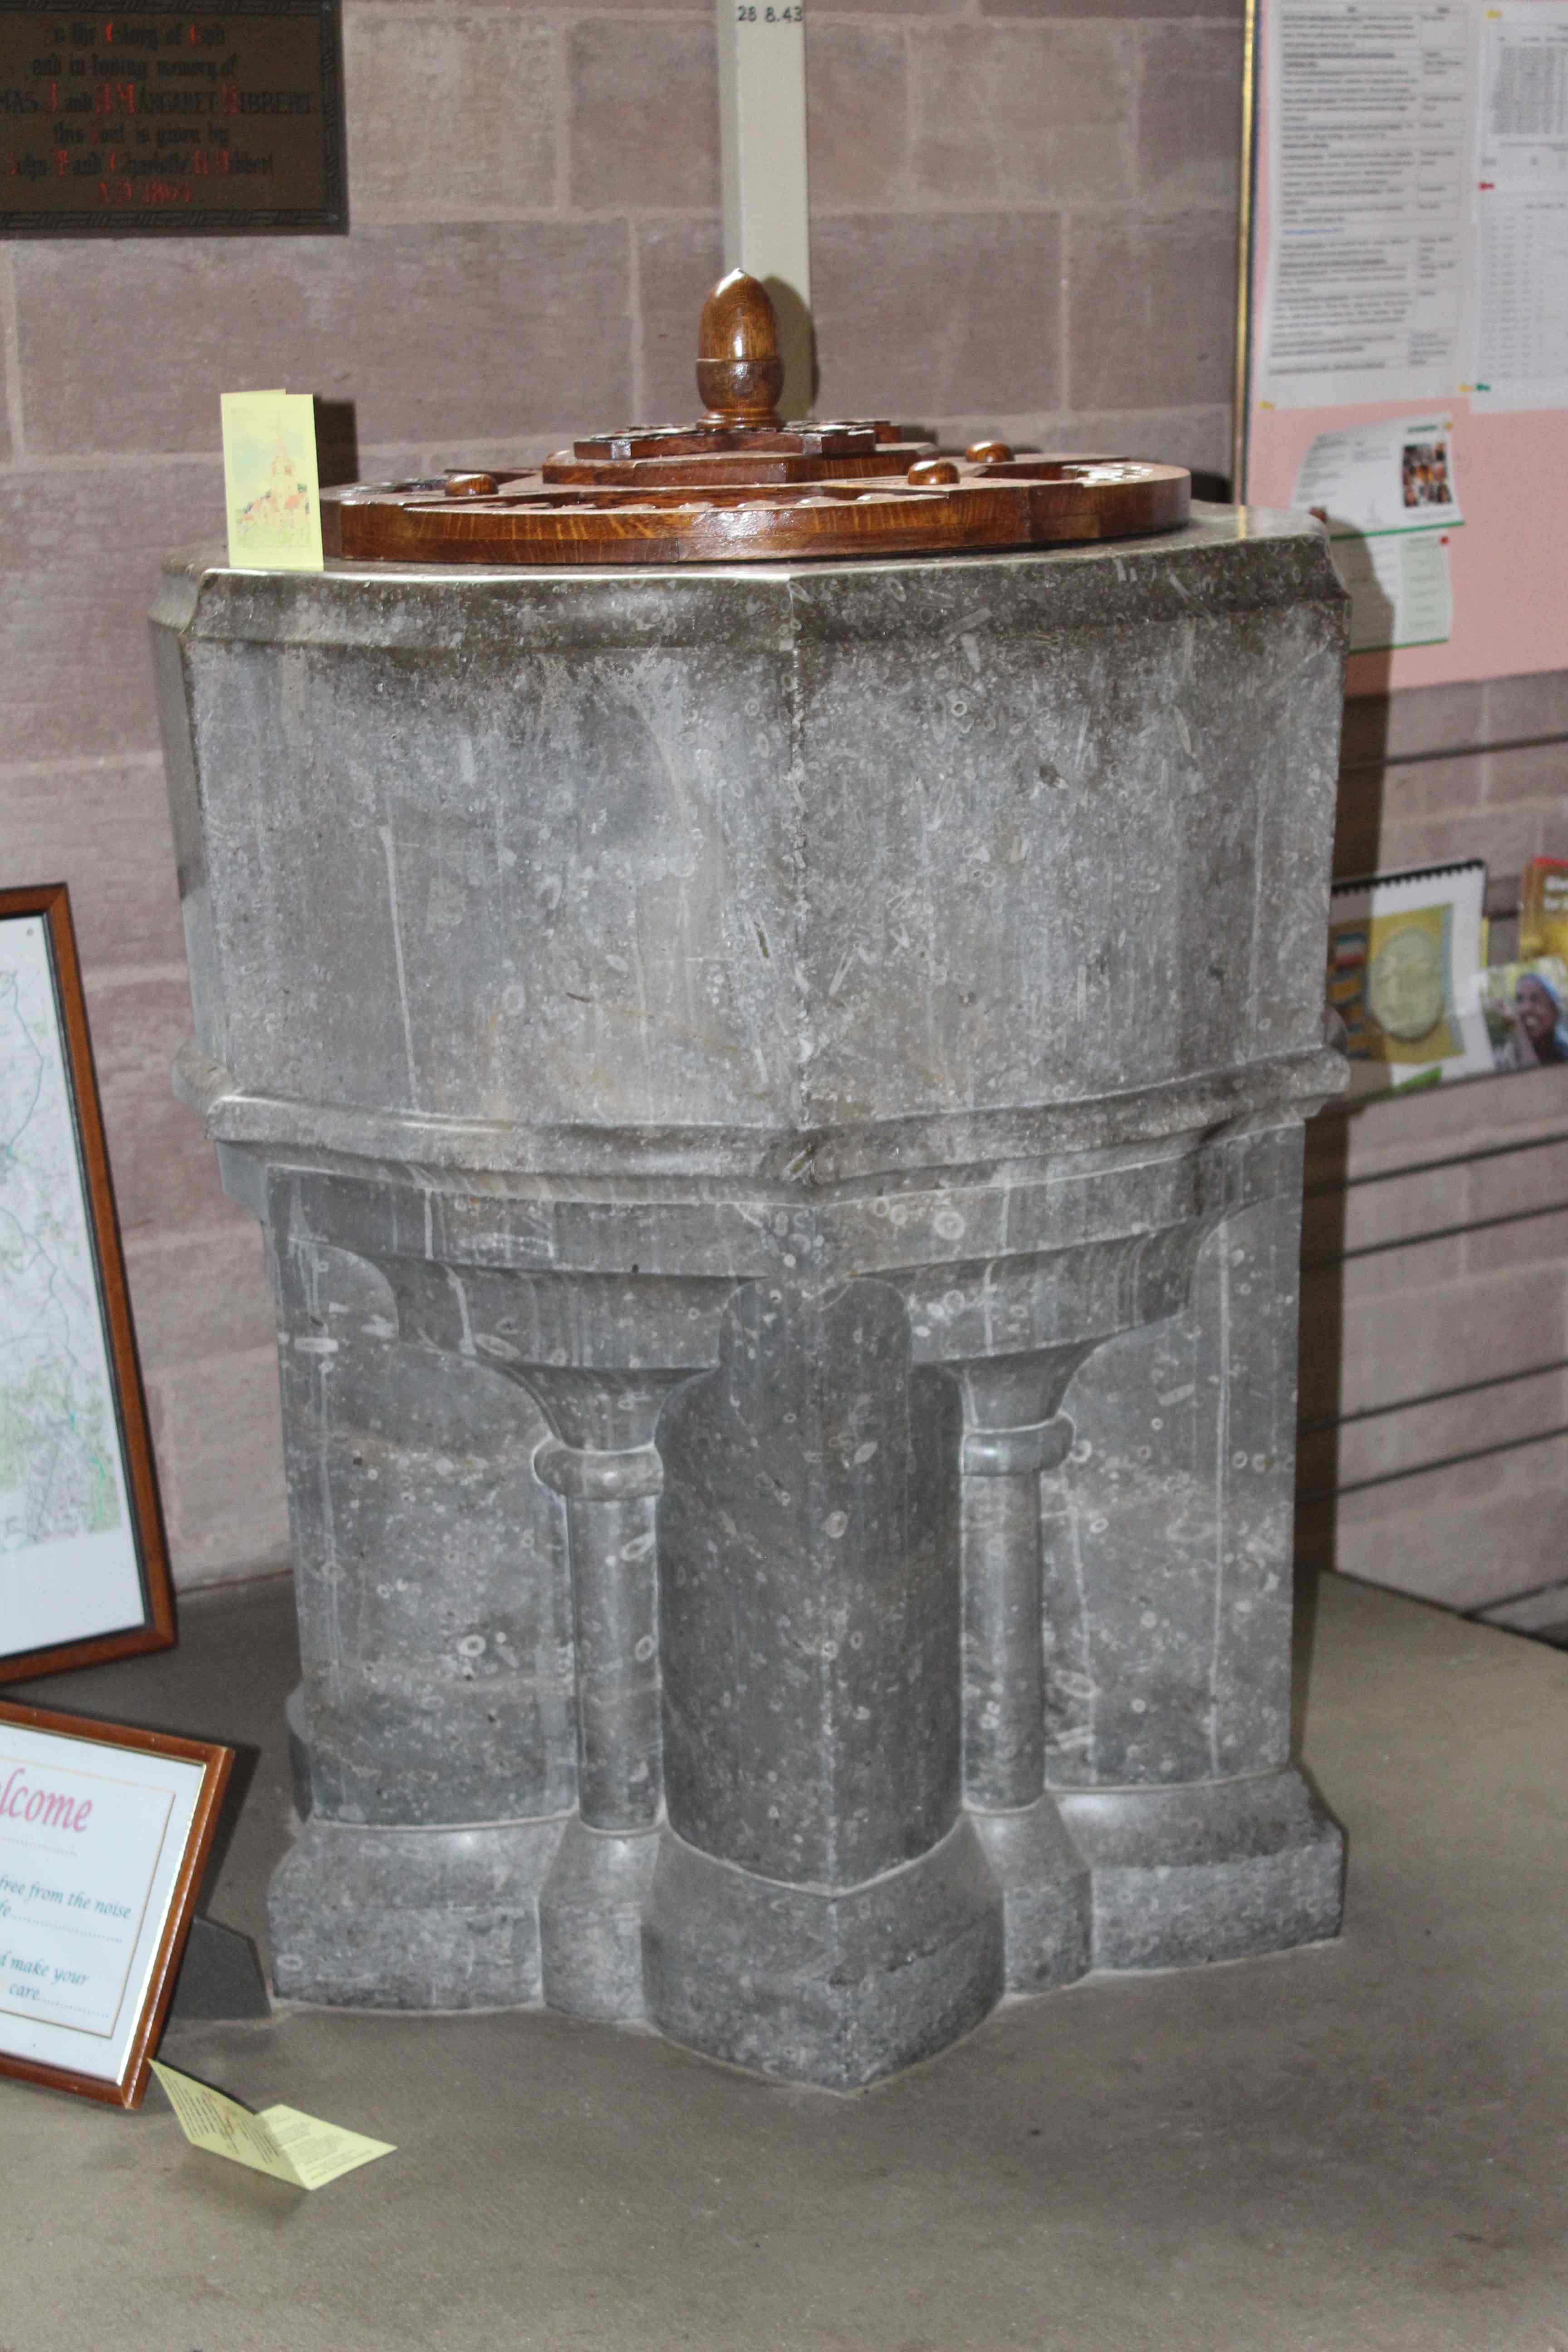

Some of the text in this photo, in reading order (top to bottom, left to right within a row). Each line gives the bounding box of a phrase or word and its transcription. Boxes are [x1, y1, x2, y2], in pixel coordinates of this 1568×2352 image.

[0, 1768, 93, 1832] lcome
[23, 1881, 63, 1904] from
[67, 1891, 91, 1910] the
[94, 1900, 131, 1919] noise
[10, 1957, 49, 1977] make
[50, 1967, 91, 1986] your
